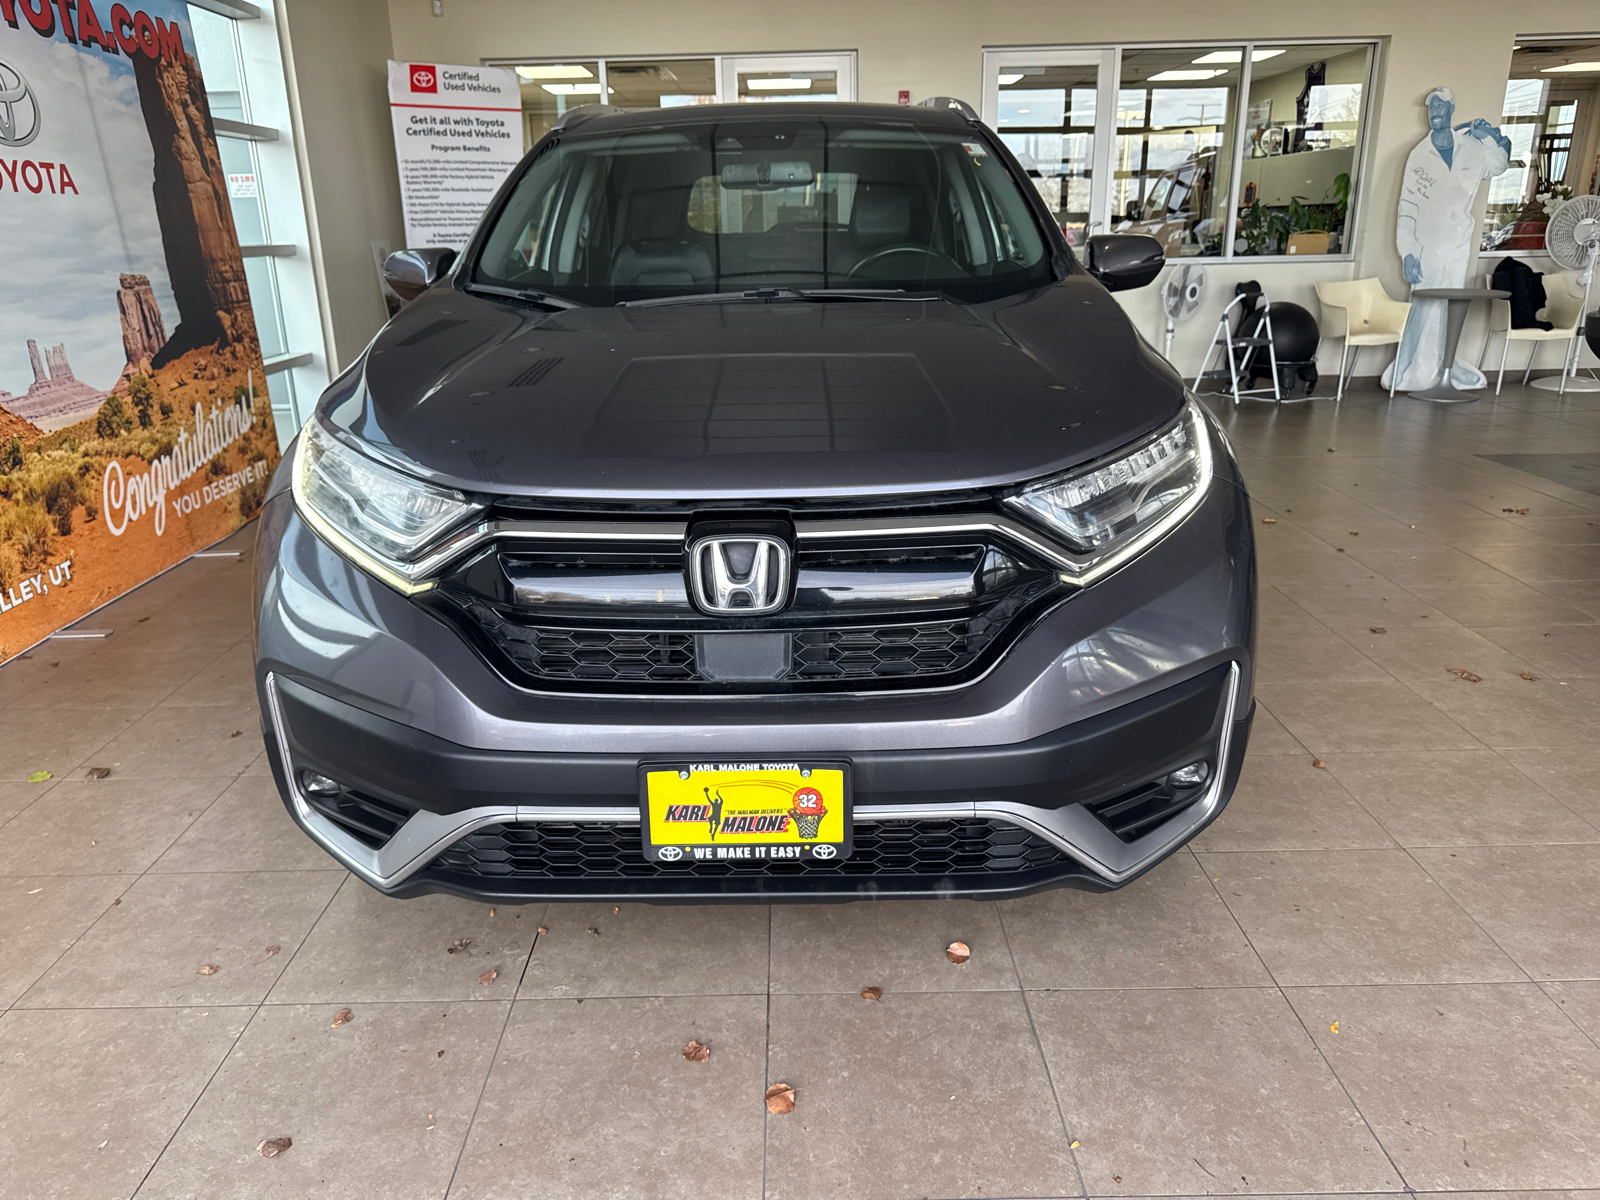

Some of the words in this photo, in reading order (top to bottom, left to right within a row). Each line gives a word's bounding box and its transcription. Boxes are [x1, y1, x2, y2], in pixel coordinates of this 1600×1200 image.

[443, 71, 480, 82] Certified
[444, 82, 465, 92] Used
[467, 83, 501, 94] Vehicles
[410, 115, 428, 124] Get
[430, 116, 437, 125] it
[439, 117, 451, 126] all
[453, 117, 473, 126] with
[475, 118, 505, 128] Toyota
[406, 127, 448, 137] Certified
[449, 129, 472, 138] Used
[473, 129, 511, 139] Vehicles
[431, 144, 461, 153] Program
[0, 159, 79, 195] YOTA
[103, 370, 258, 537] Congratulations!
[172, 493, 202, 518] YOU
[203, 465, 255, 504] DESERVE
[255, 459, 268, 483] IT!
[0, 573, 48, 614] LLEY,
[48, 559, 71, 586] UT
[689, 764, 717, 772] KARL
[718, 764, 760, 772] MALONE
[761, 763, 800, 771] TOYOTA
[798, 794, 817, 808] 32
[664, 805, 711, 823] KARL
[720, 814, 790, 834] MALONE
[693, 847, 713, 859] WE
[717, 847, 751, 859] MAKE
[755, 846, 766, 858] IT
[770, 846, 802, 858] EASY
